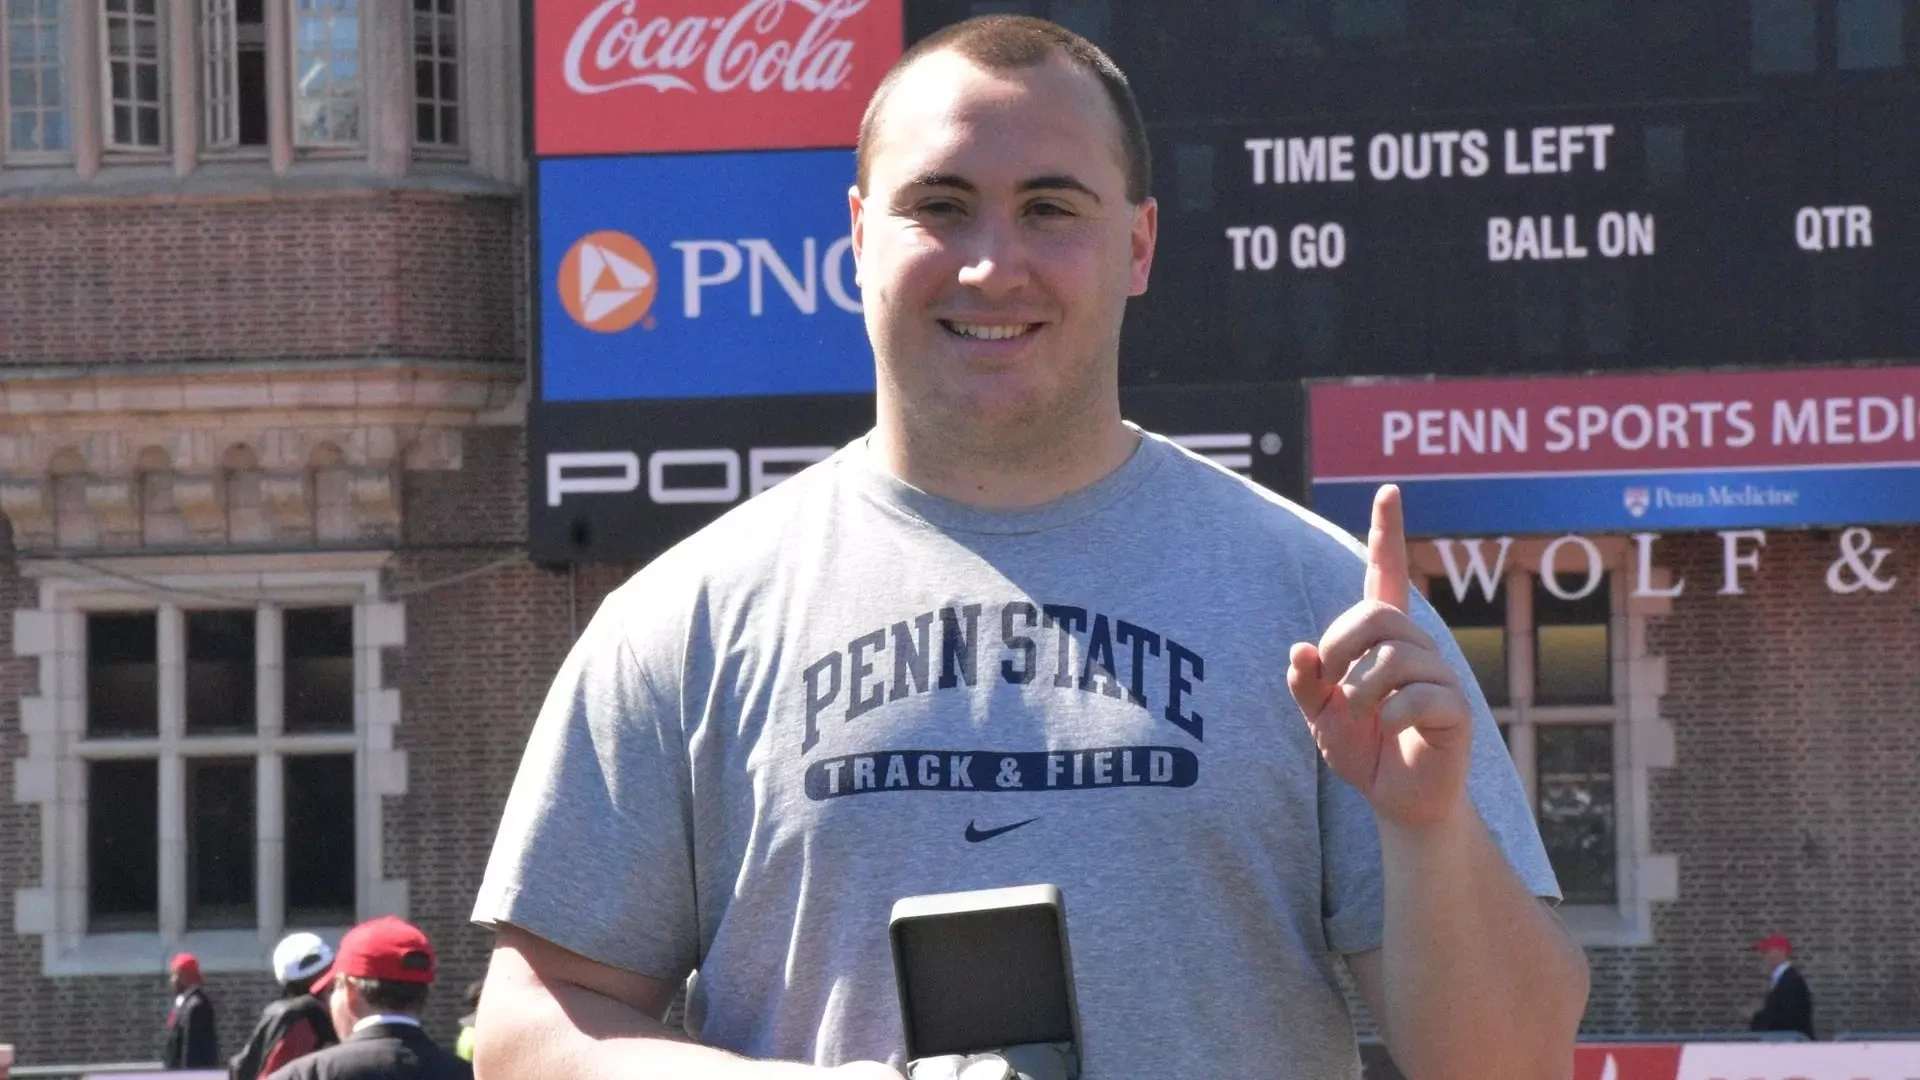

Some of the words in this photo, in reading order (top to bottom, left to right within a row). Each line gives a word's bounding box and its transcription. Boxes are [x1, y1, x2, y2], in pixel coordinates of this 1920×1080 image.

[562, 0, 860, 94] Coca-Cola
[1245, 136, 1355, 184] TIME
[1368, 129, 1490, 181] OUTS
[1504, 125, 1614, 174] LEFT
[1226, 225, 1277, 270] TO
[1289, 223, 1346, 268] GO
[1487, 216, 1587, 261] BALL
[1597, 212, 1654, 257] ON
[1795, 206, 1873, 251] QTR
[1381, 408, 1528, 456] PENN
[1544, 401, 1755, 452] SPORTS
[1771, 394, 1920, 446] MEDI
[1655, 486, 1705, 508] Penn
[1708, 484, 1799, 507] Medicine
[1433, 530, 1767, 604] WOLF
[1826, 526, 1898, 594] &
[801, 603, 982, 757] PENN
[1000, 601, 1205, 743] STATE
[823, 754, 976, 794] TRACK
[995, 756, 1024, 789] &
[1046, 749, 1173, 787] FIELD
